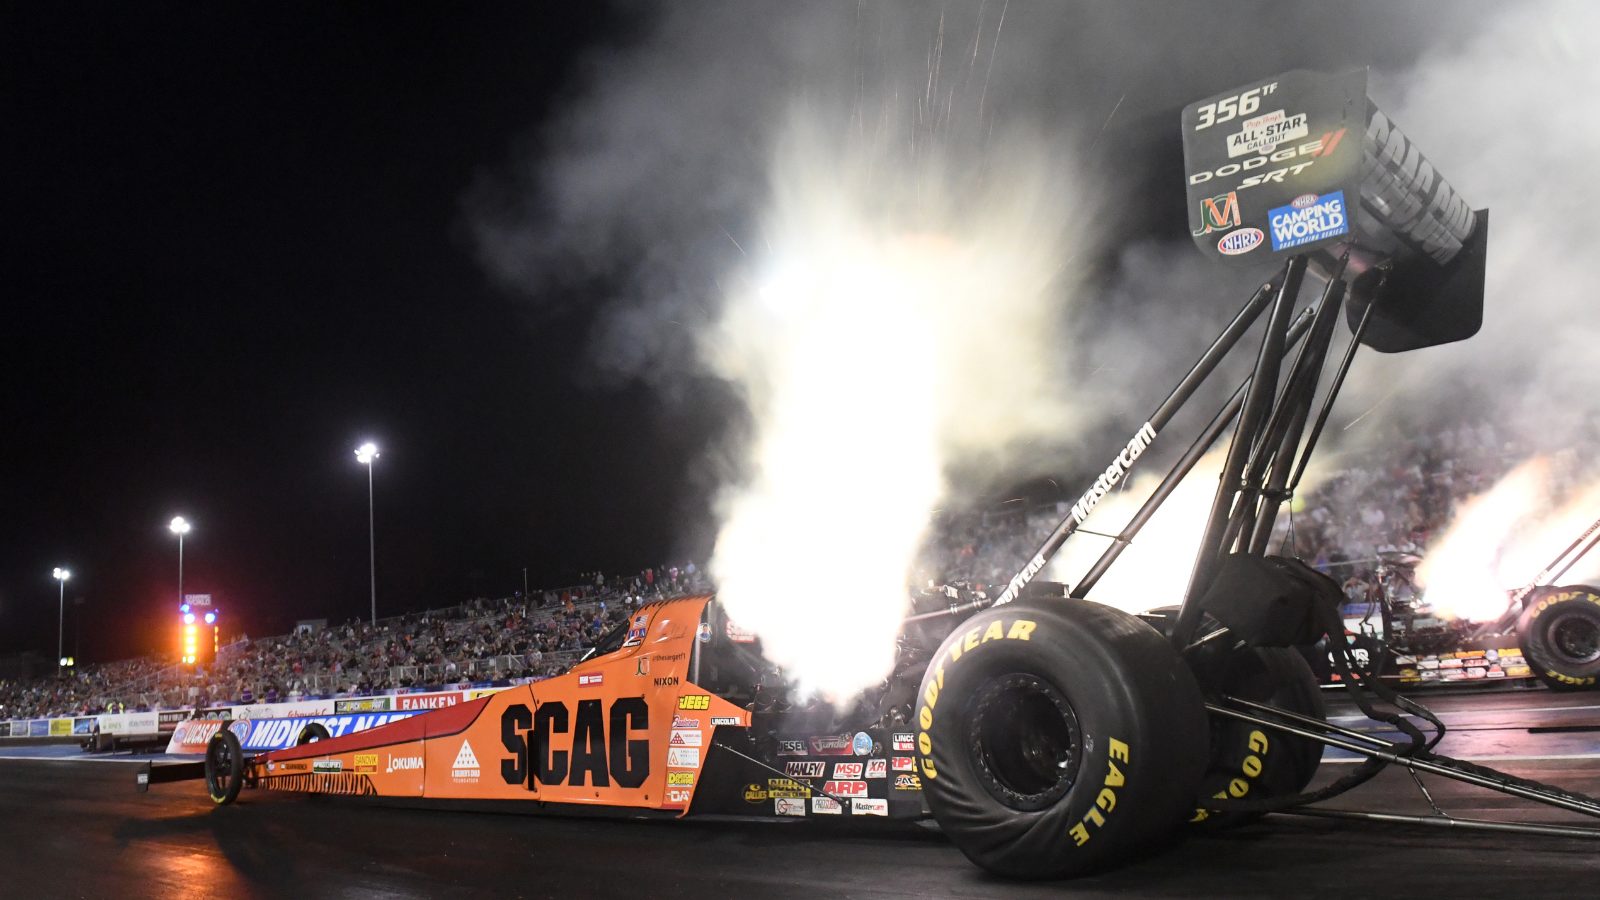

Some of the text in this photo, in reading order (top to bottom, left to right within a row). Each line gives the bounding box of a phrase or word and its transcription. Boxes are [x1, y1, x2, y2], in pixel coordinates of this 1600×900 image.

[1195, 82, 1278, 131] 356 TF
[1247, 134, 1285, 150] CALLOUT
[1189, 139, 1323, 185] DODGE
[1237, 161, 1314, 190] SRT
[1272, 200, 1342, 229] CAMPING
[1274, 212, 1343, 242] WORLD
[1225, 232, 1257, 250] NHRA
[1071, 421, 1156, 524] Mastercam
[653, 677, 679, 686] NIXON
[402, 697, 456, 711] RANKEN
[679, 695, 711, 710] JEGS
[918, 619, 1037, 780] GOODYEAR
[711, 717, 735, 726] LINCOLN
[247, 716, 353, 748] MIDWST
[501, 697, 650, 788] SCAG
[779, 740, 807, 752] JESEL
[355, 754, 377, 765] SANDVIK
[392, 758, 424, 770] OKUMA
[868, 761, 887, 772] XR
[785, 762, 820, 777] MANLEY
[835, 764, 862, 775] MSD
[823, 781, 868, 795] ARP
[1068, 736, 1130, 847] EAGLE
[854, 802, 885, 812] Mastercam
